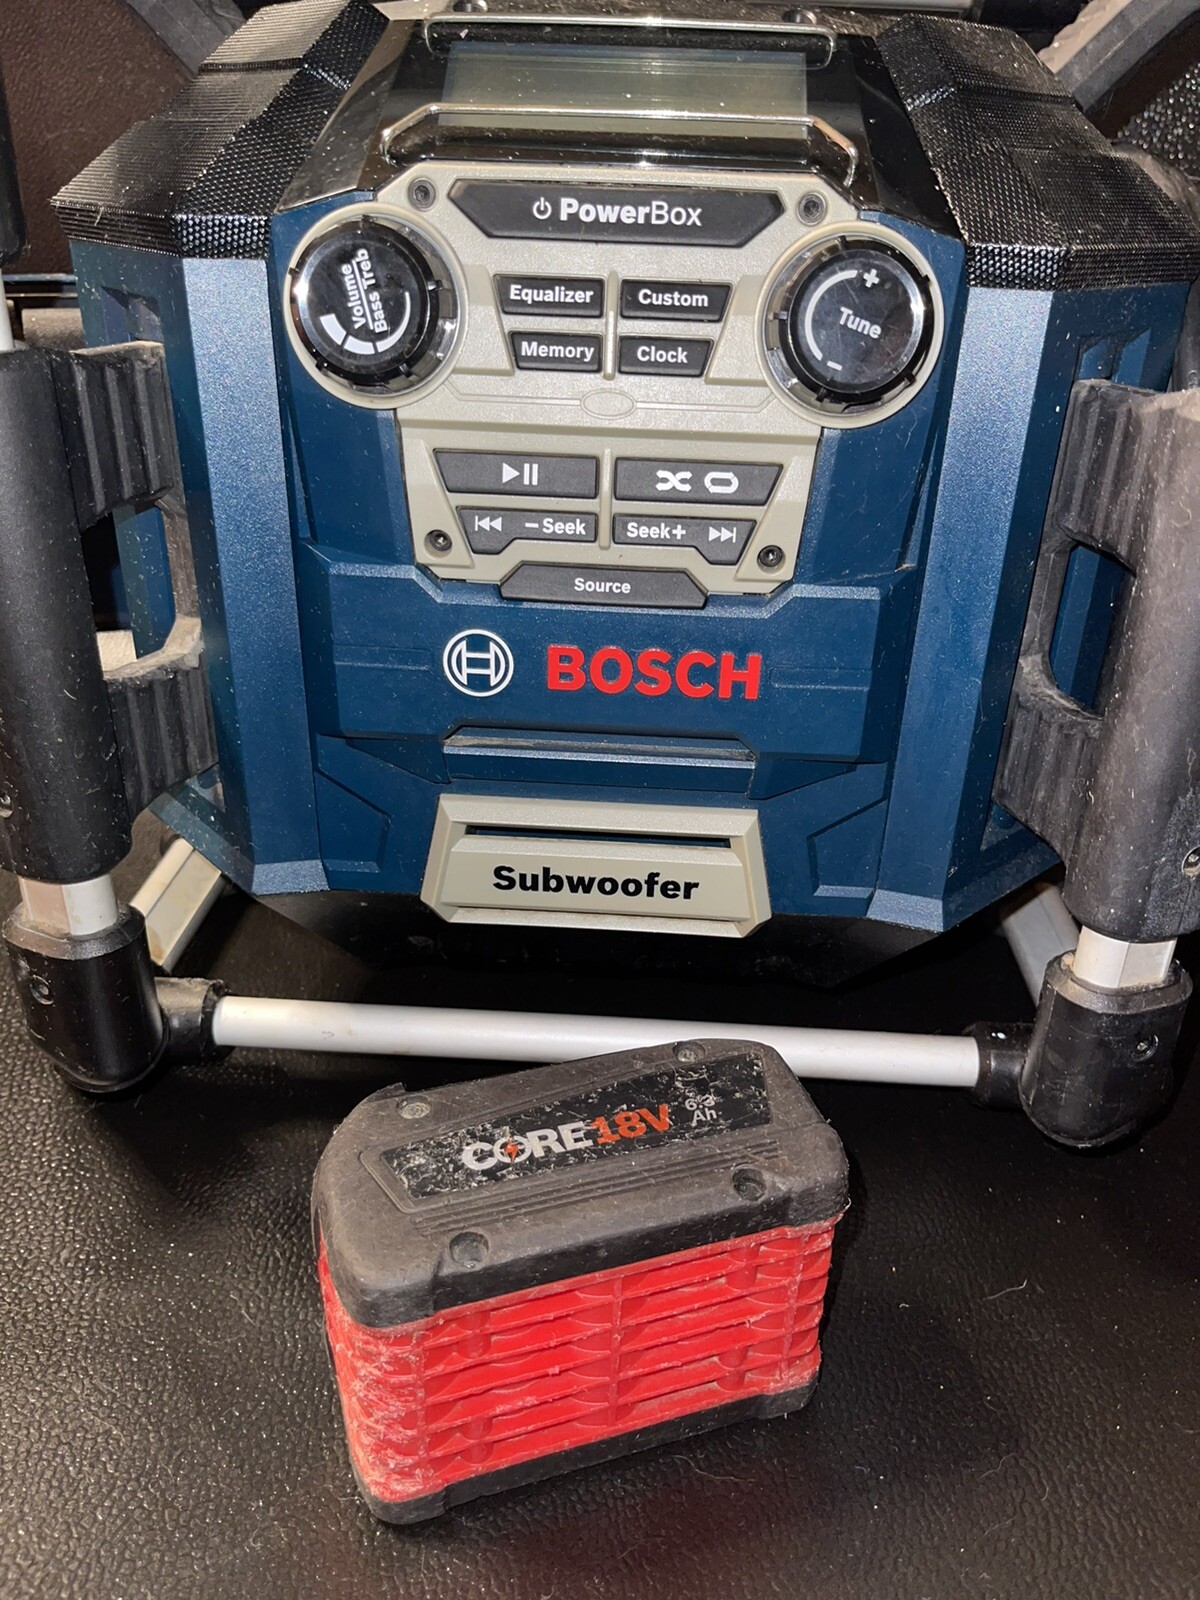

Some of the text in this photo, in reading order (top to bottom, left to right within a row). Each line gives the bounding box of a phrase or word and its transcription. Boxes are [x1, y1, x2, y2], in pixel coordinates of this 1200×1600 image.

[559, 197, 702, 226] PowerBox
[341, 263, 367, 329] Volume
[355, 248, 388, 333] Bass Treb
[509, 284, 593, 304] Equalizer
[638, 288, 709, 307] Custom
[839, 306, 882, 339] Tune
[521, 341, 594, 362] Memory
[637, 345, 688, 363] Clock
[574, 577, 631, 594] Source
[546, 644, 763, 700] BOSCH
[492, 865, 700, 900] Subwoofer
[692, 1107, 718, 1126] Ah
